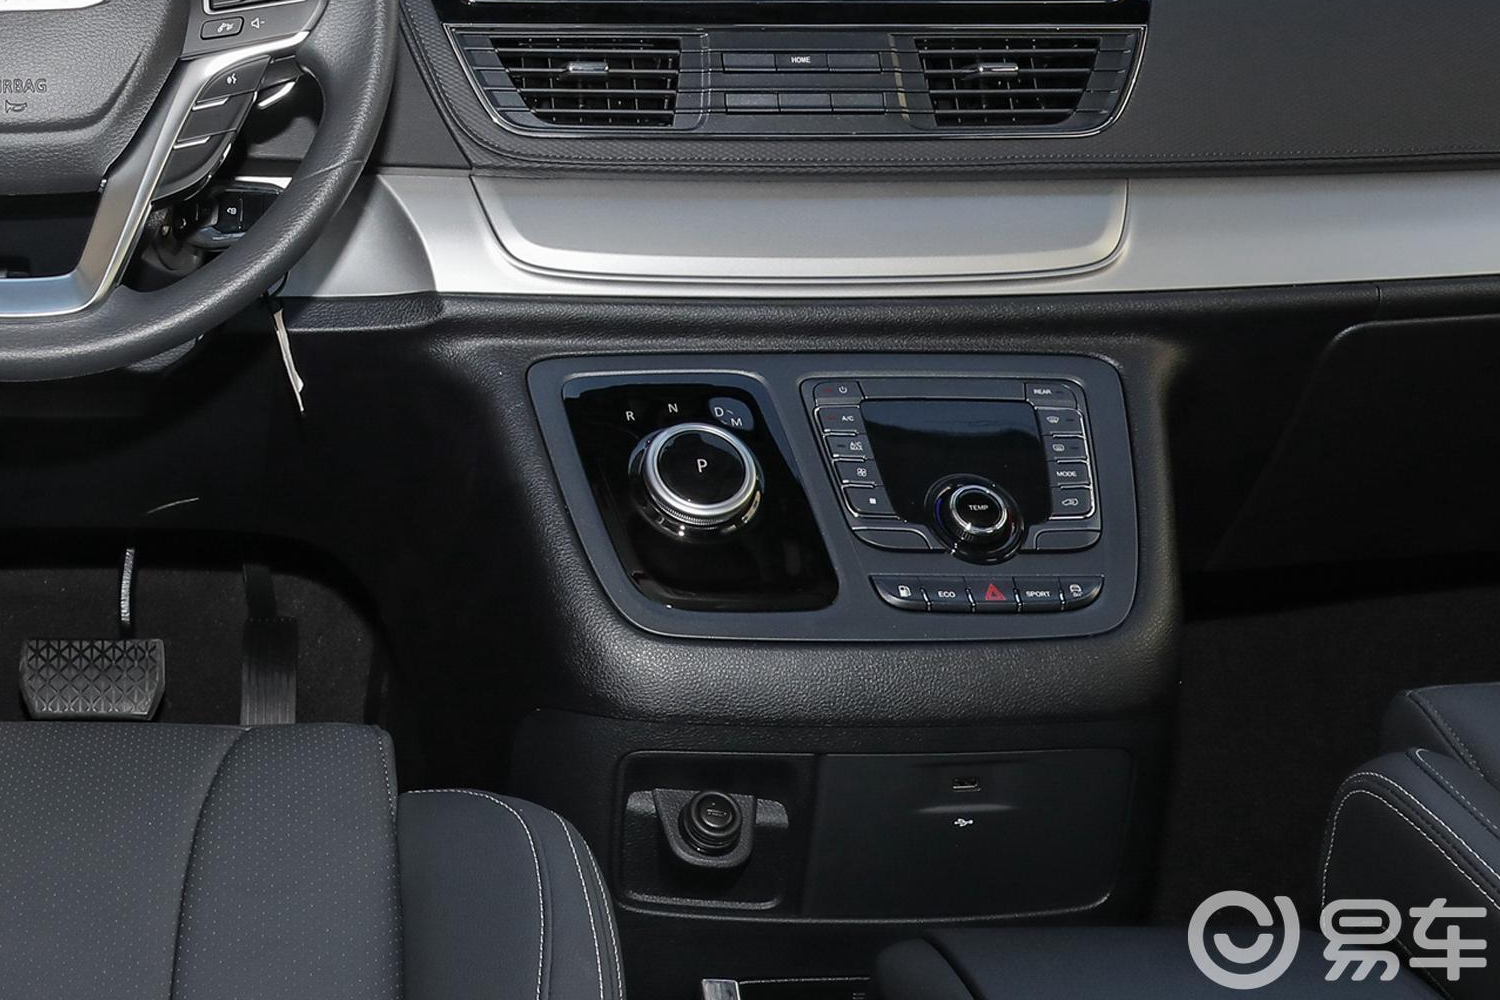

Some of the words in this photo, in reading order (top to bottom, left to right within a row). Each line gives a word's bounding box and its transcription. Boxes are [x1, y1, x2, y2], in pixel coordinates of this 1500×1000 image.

[790, 56, 811, 64] HOME
[668, 403, 679, 414] N
[714, 406, 725, 417] D
[625, 410, 636, 421] R
[730, 417, 743, 427] M
[697, 458, 708, 473] P
[937, 590, 956, 598] ECO
[1025, 590, 1051, 598] SPORT
